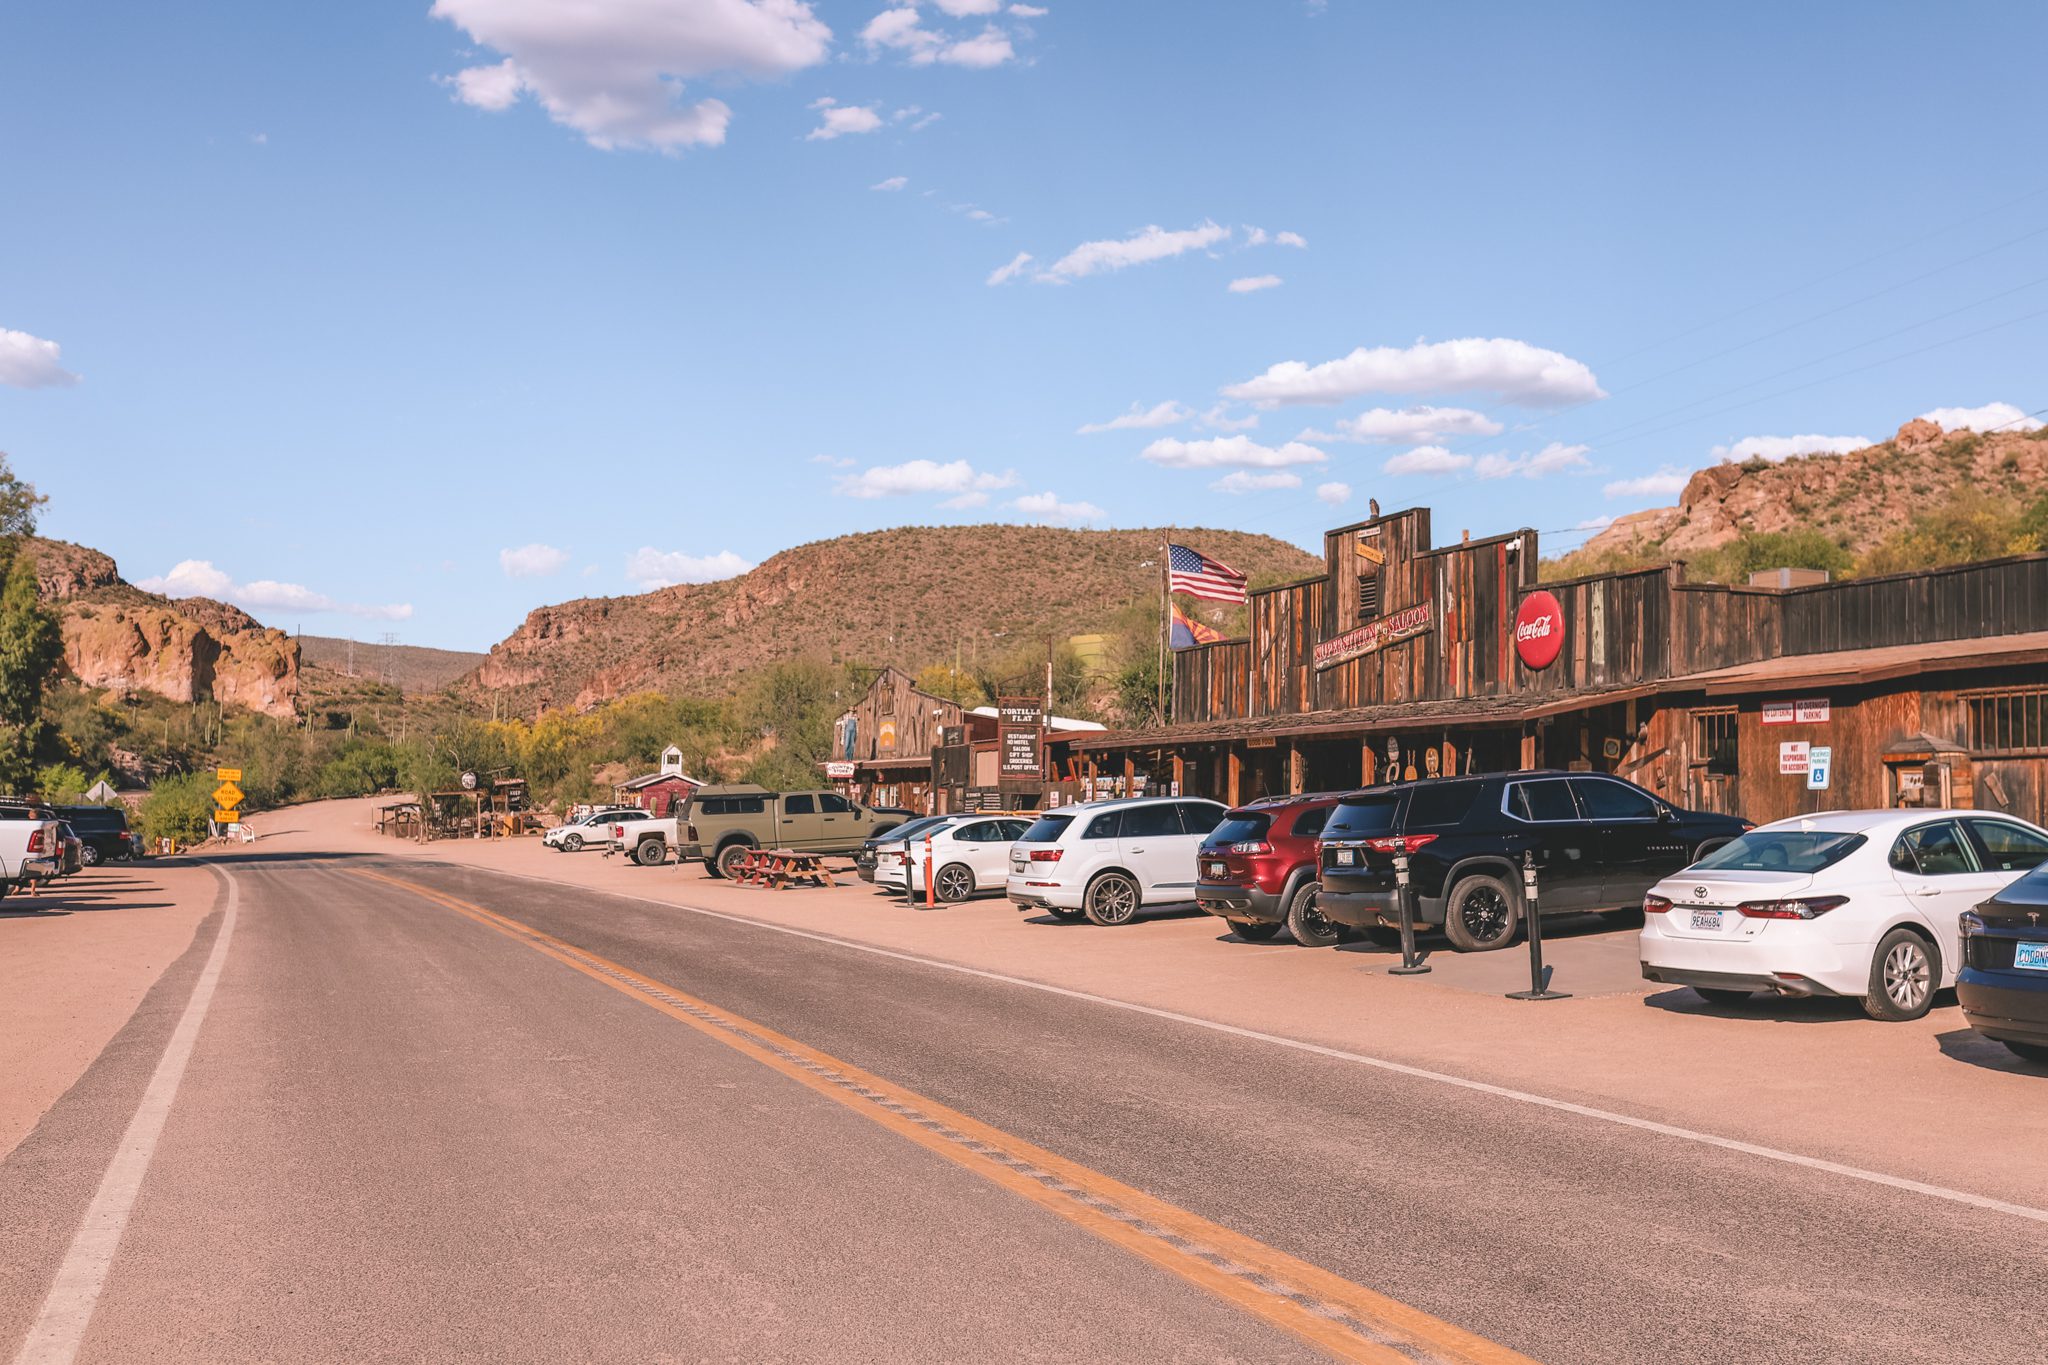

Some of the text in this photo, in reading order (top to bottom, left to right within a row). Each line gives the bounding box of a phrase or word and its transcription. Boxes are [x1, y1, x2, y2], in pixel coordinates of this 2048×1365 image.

[1315, 605, 1429, 660] SUPERSTITION SALOON
[1517, 615, 1552, 642] Coca-Cola
[1797, 701, 1828, 711] NO OVERNIGHT
[1764, 707, 1792, 718] NO LOITERING
[1803, 711, 1822, 720] PARKING
[1791, 744, 1799, 752] NOT
[1691, 915, 1721, 928] 9EAH684
